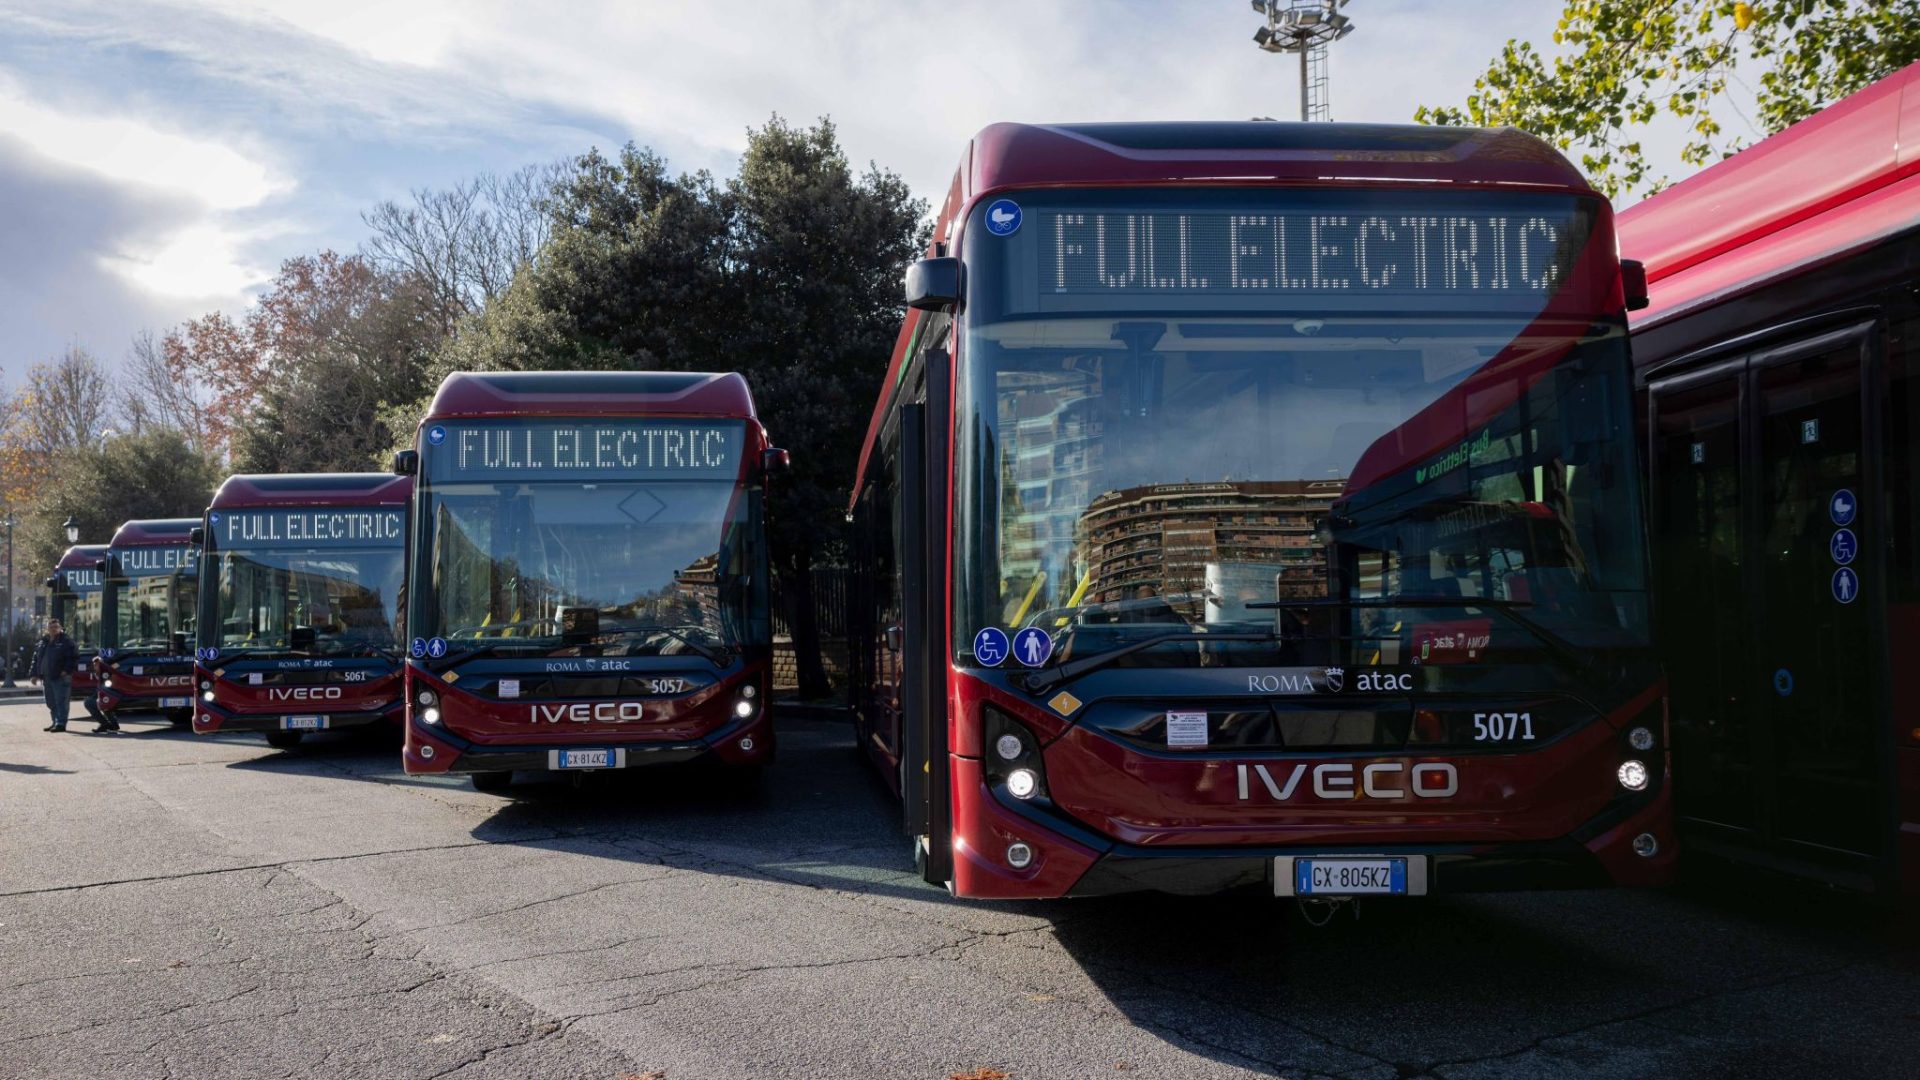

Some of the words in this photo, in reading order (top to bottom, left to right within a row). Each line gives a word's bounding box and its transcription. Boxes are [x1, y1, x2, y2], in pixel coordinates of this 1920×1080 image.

[1056, 214, 1208, 289] FULL
[1231, 215, 1558, 289] ELECTRIC
[459, 430, 542, 469] FULL
[554, 430, 725, 468] ELECTRIC
[229, 515, 280, 541] FULL
[287, 513, 399, 540] ELECTRIC
[121, 550, 161, 570] FULL
[67, 570, 101, 586] FULL
[278, 661, 301, 669] ROMA
[313, 660, 334, 668] atac
[546, 662, 581, 673] ROMA
[601, 660, 630, 671] atac
[344, 671, 366, 681] 5061
[1247, 675, 1316, 692] ROMA
[1357, 670, 1413, 691] atac
[269, 687, 342, 701] IVECO
[652, 679, 684, 694] 5057
[531, 702, 643, 723] IVECO
[1473, 712, 1535, 741] 5071
[1236, 762, 1459, 801] IVECO
